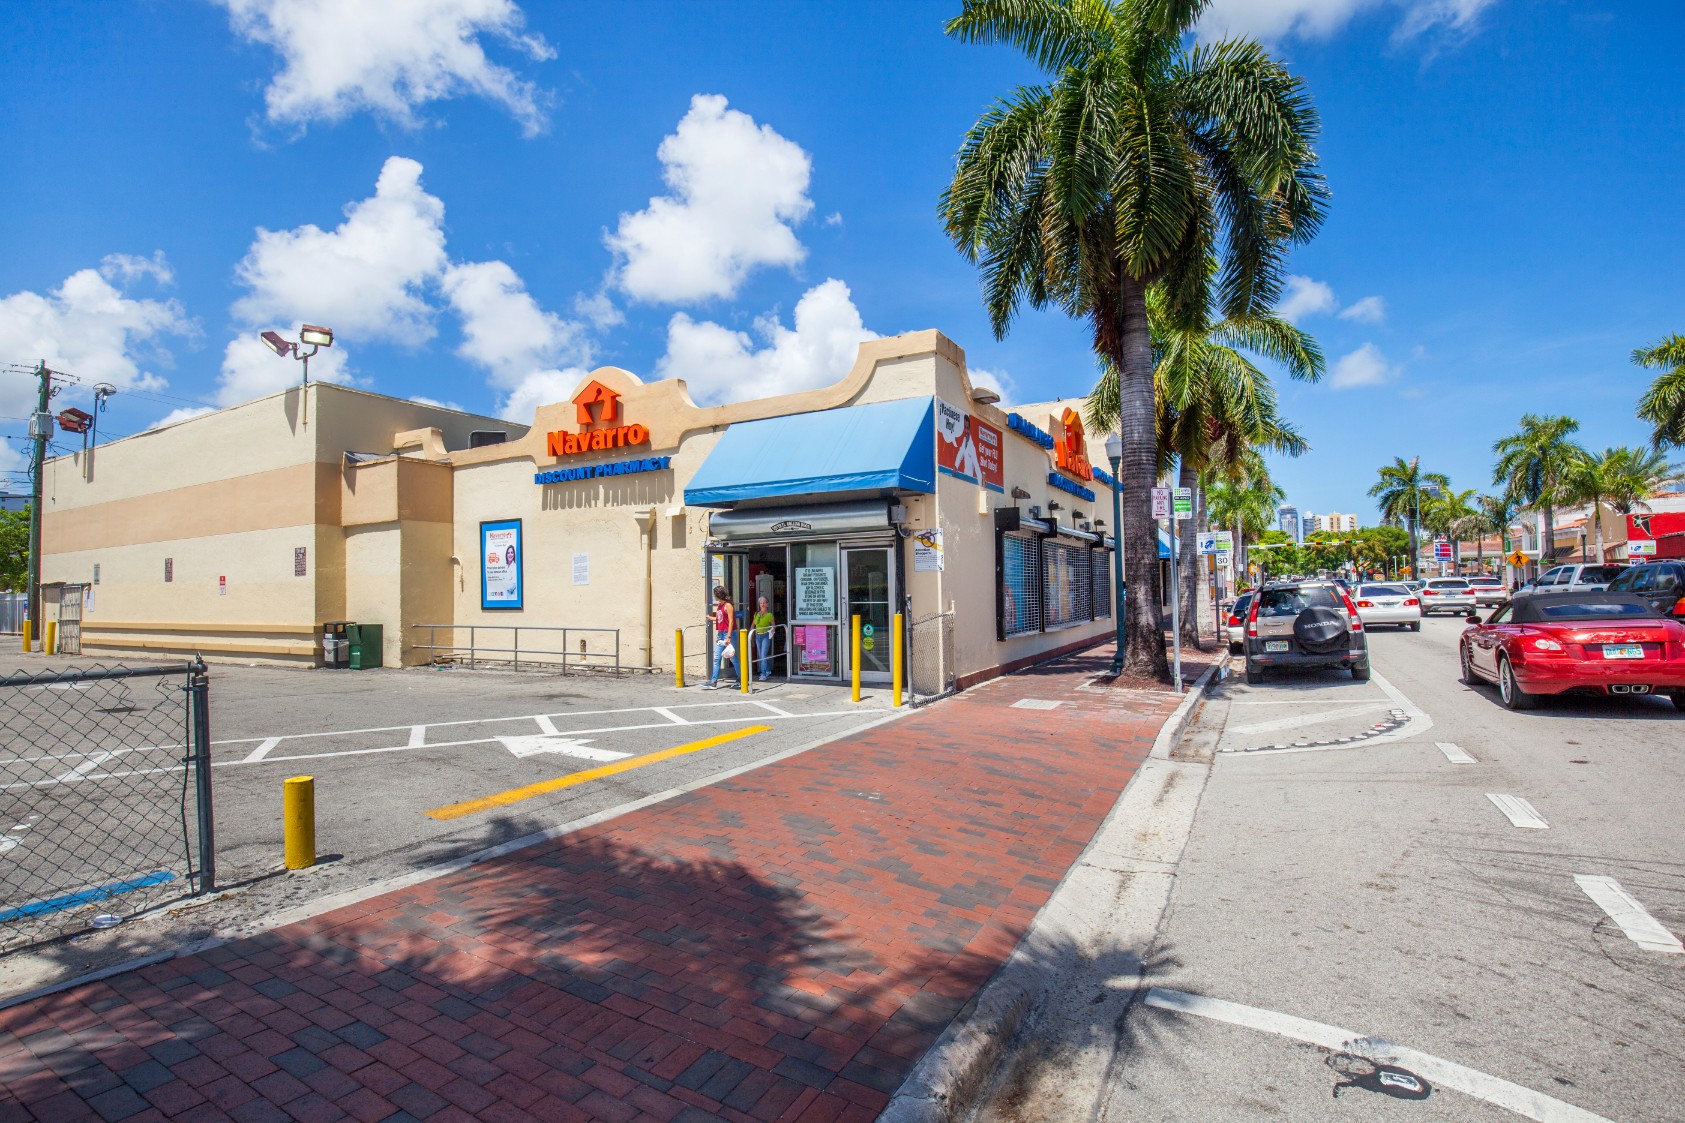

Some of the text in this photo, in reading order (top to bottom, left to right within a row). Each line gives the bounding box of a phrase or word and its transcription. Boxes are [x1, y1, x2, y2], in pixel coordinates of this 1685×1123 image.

[548, 424, 649, 456] Navarro
[534, 456, 671, 484] DISCOUNT PHARMACY
[1304, 620, 1340, 629] HONDA
